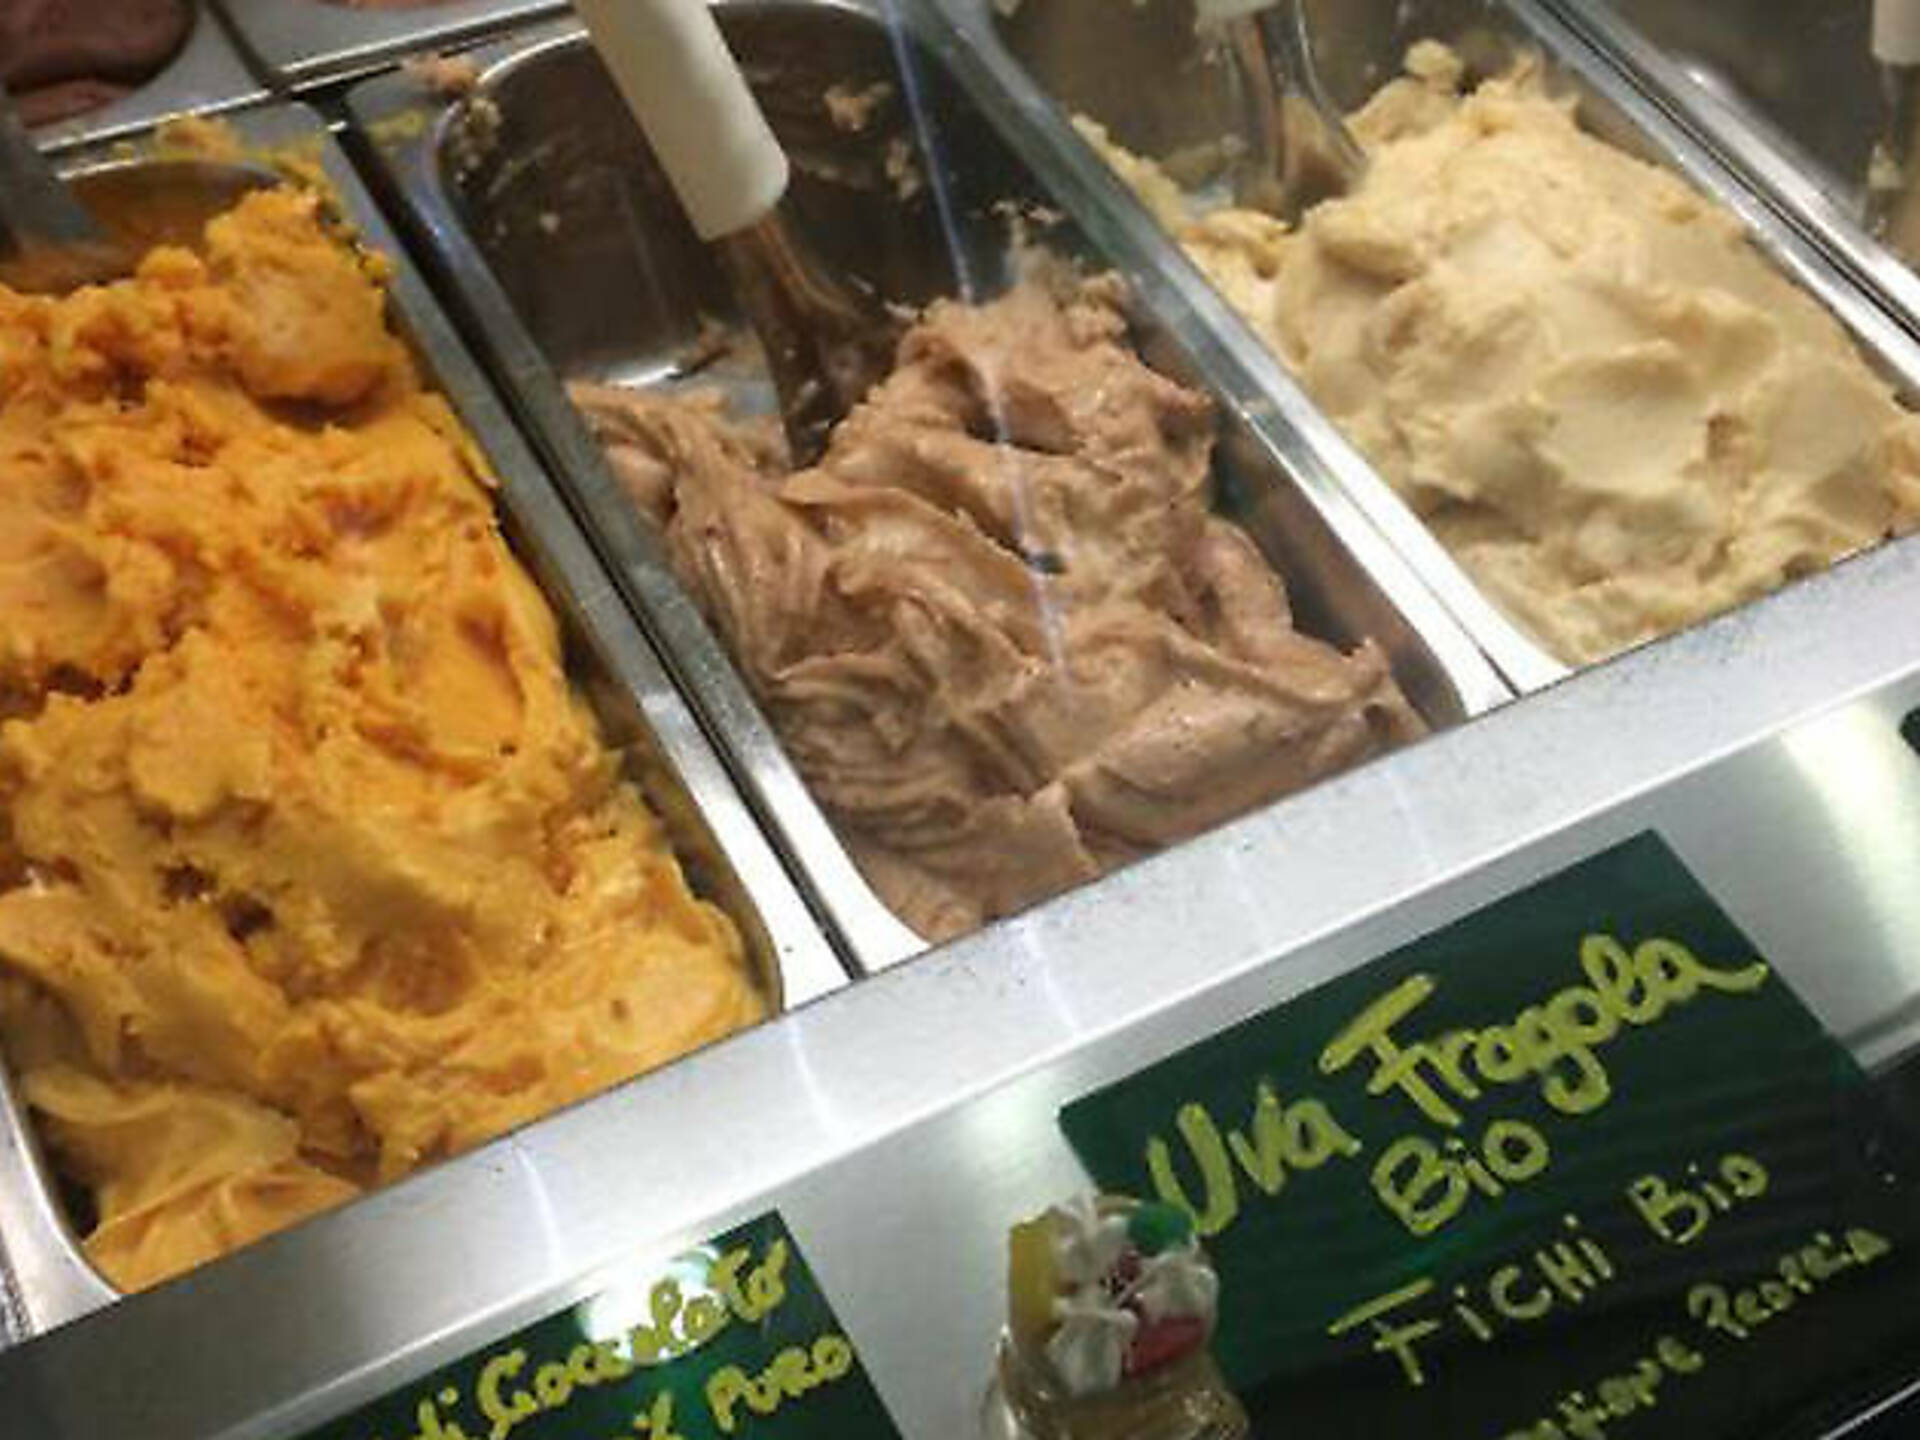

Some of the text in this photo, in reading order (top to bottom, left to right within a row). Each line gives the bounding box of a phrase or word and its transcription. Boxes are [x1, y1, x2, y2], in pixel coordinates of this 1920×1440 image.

[1146, 932, 1770, 1238] Uva Fragola
[1370, 1119, 1550, 1236] Bio
[1628, 1153, 1769, 1243] Bio
